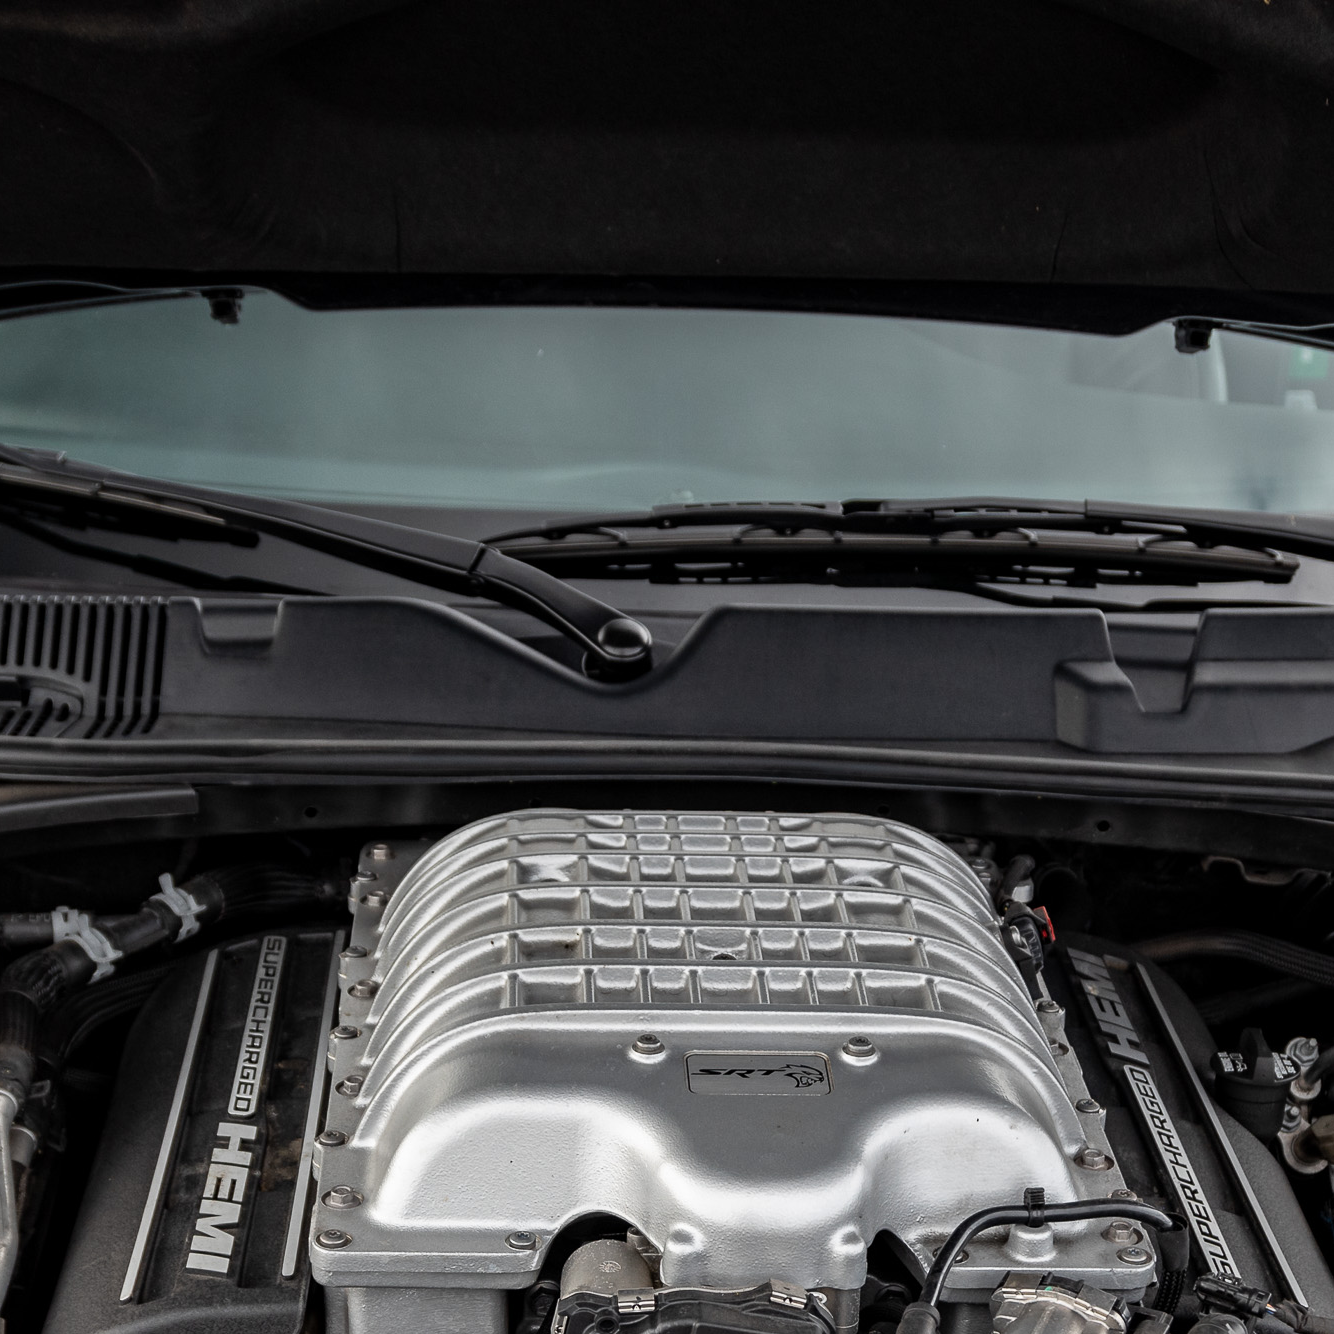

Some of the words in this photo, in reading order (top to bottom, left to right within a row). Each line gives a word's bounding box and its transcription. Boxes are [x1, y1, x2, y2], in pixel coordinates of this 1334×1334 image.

[231, 936, 284, 1114] SUPERCHARGED
[690, 1068, 787, 1078] SRT
[1067, 947, 1151, 1066] HEMI
[186, 1121, 258, 1275] HEMI
[1126, 1067, 1237, 1278] SUPERCHARGED
